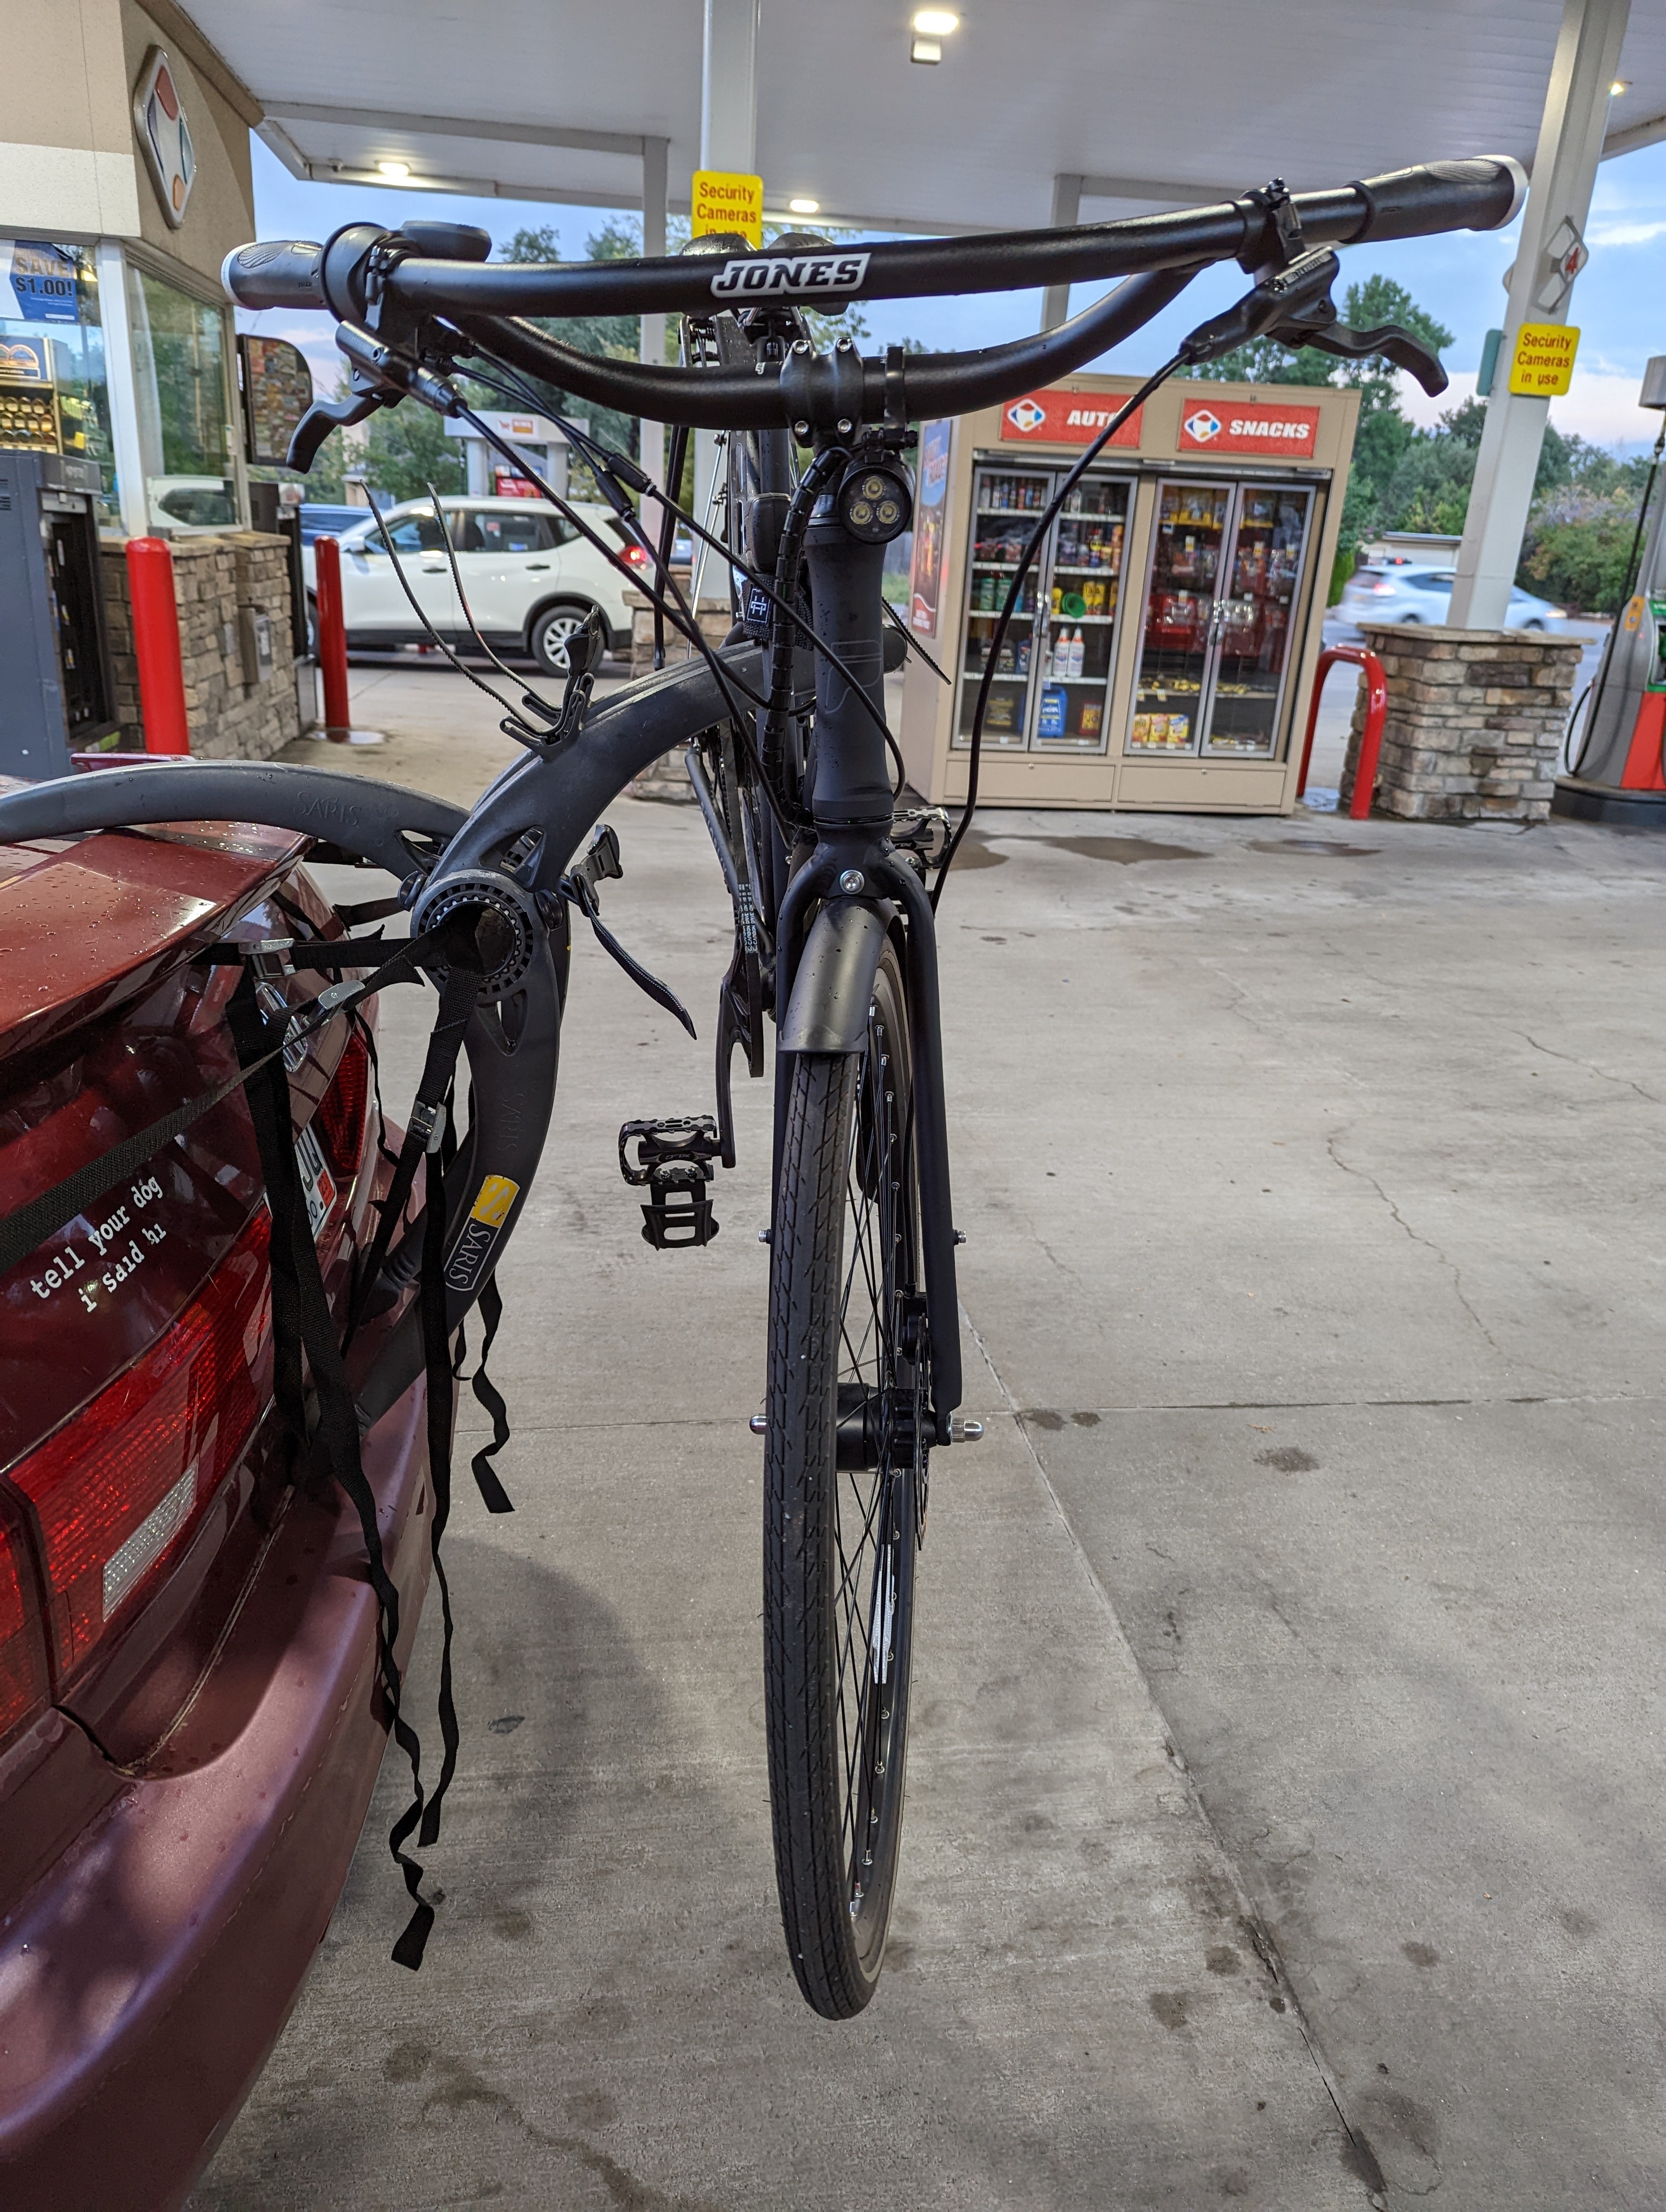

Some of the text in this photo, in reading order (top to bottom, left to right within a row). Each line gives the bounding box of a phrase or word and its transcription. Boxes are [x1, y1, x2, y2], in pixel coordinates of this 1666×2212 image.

[699, 182, 754, 204] Security
[697, 203, 756, 223] Cameras
[15, 256, 70, 277] SAVE
[716, 260, 862, 291] JONES
[15, 276, 73, 297] $1.00!
[1522, 332, 1572, 351] Security
[1517, 351, 1570, 368] Cameras
[1521, 369, 1559, 386] in use
[1229, 419, 1311, 440] SNACKS
[296, 791, 362, 826] SARIS
[30, 1176, 163, 1298] tell your dog
[448, 1223, 491, 1285] SARIS
[78, 1288, 97, 1313] i
